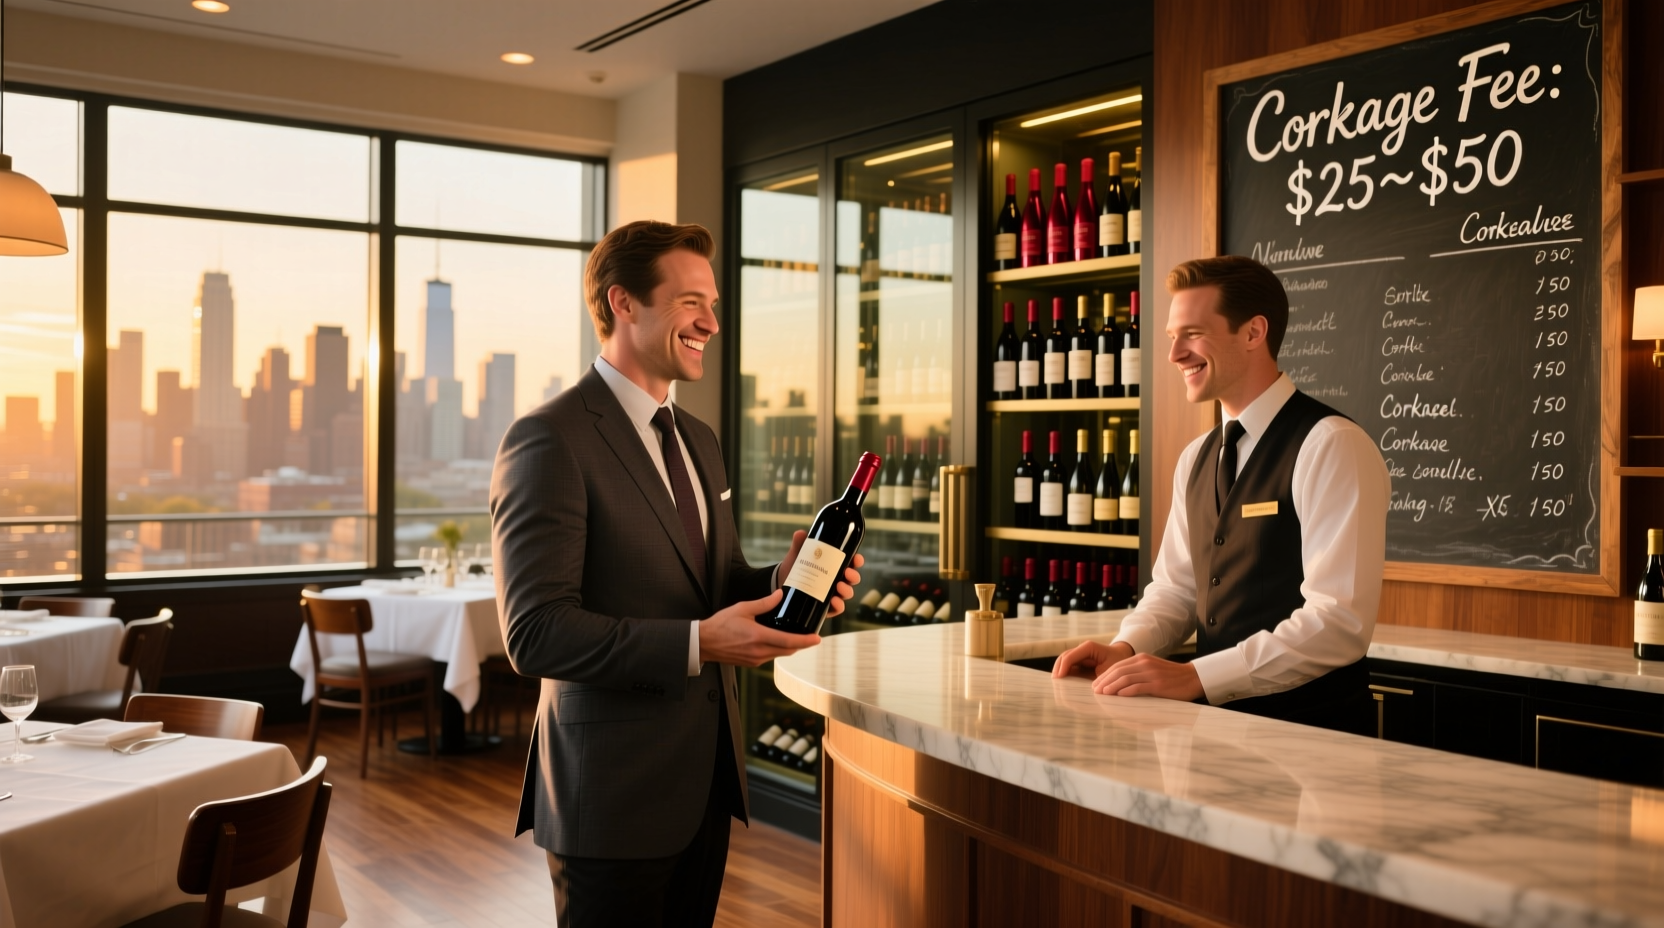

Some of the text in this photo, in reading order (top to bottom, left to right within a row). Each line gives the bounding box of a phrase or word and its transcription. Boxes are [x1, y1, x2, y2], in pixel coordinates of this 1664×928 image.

[1246, 42, 1562, 162] Corkage Fee:
[1535, 331, 1568, 349] 150
[1532, 395, 1566, 414] 150
[1530, 430, 1565, 448] 150
[1531, 461, 1564, 480] 150
